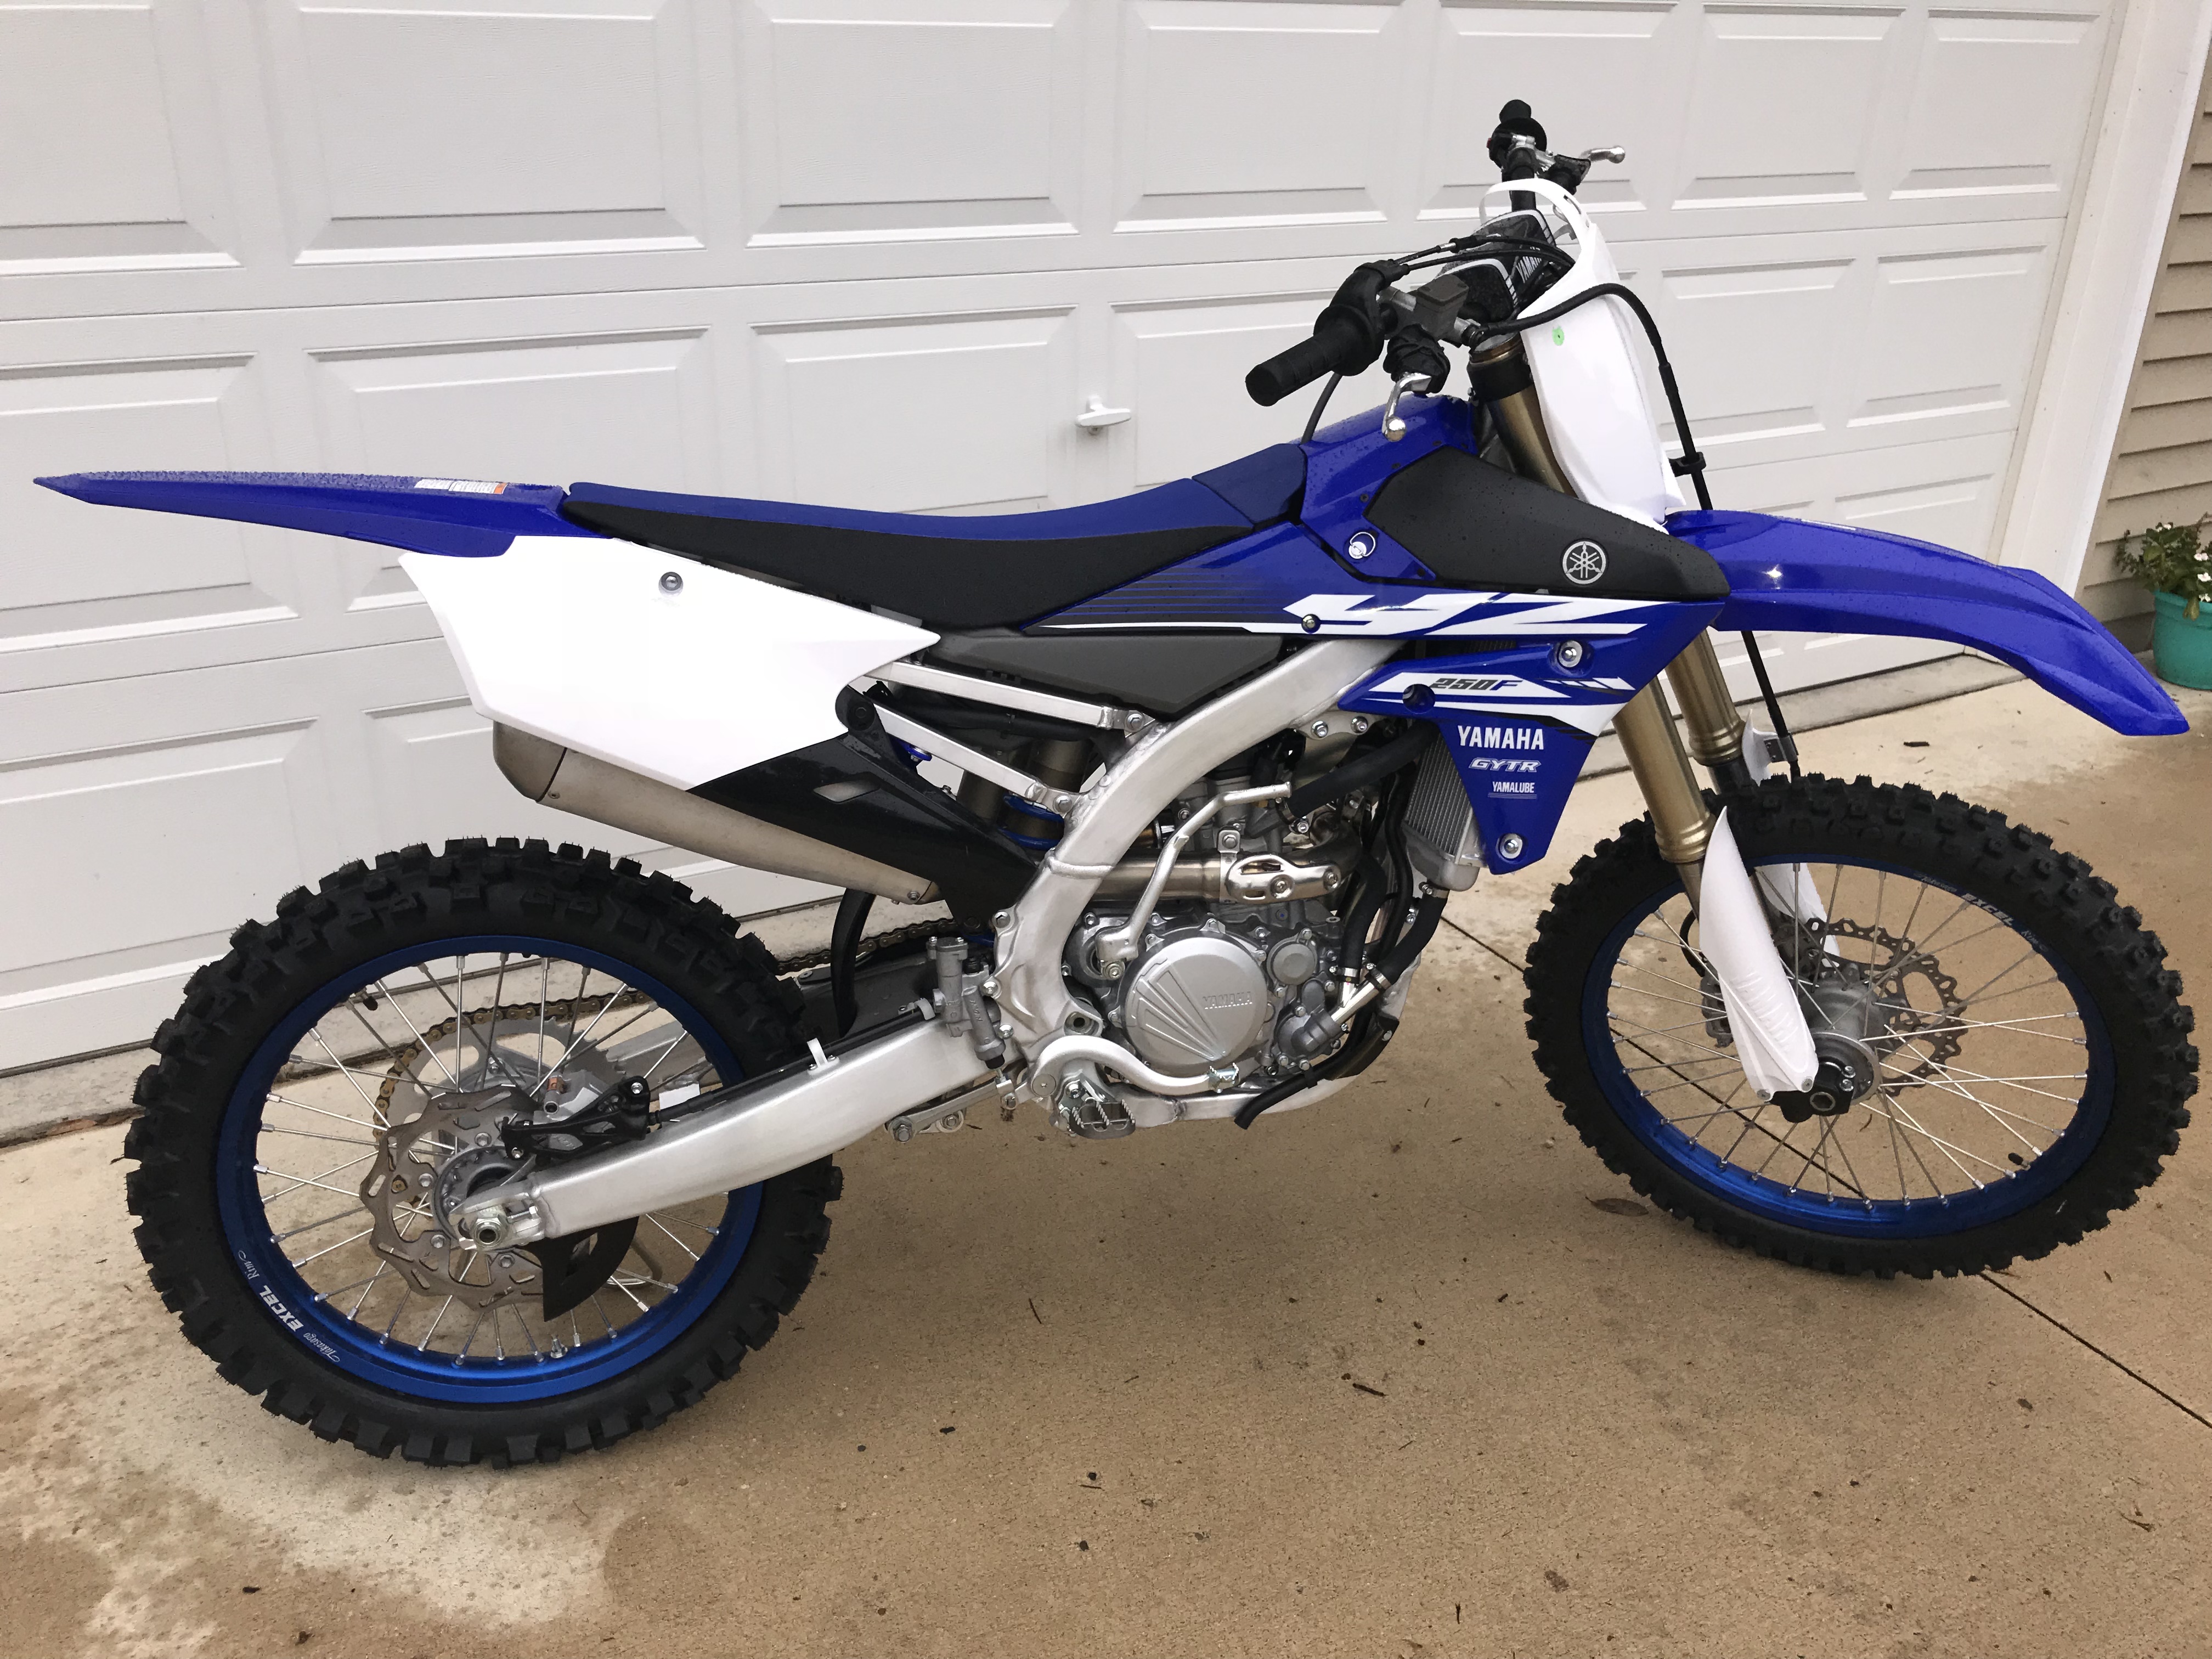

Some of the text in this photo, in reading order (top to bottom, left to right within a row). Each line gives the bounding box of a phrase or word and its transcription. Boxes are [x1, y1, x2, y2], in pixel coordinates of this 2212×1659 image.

[1429, 678, 1523, 691] 250F
[1457, 725, 1544, 750] YAMAHA
[1468, 757, 1542, 772] GYTR
[1492, 781, 1535, 793] YAMALUBE
[1961, 893, 2015, 926] EXCEL
[1203, 991, 1253, 1010] YAMAHA
[238, 1250, 341, 1363] Takasago EXCEL Rim
